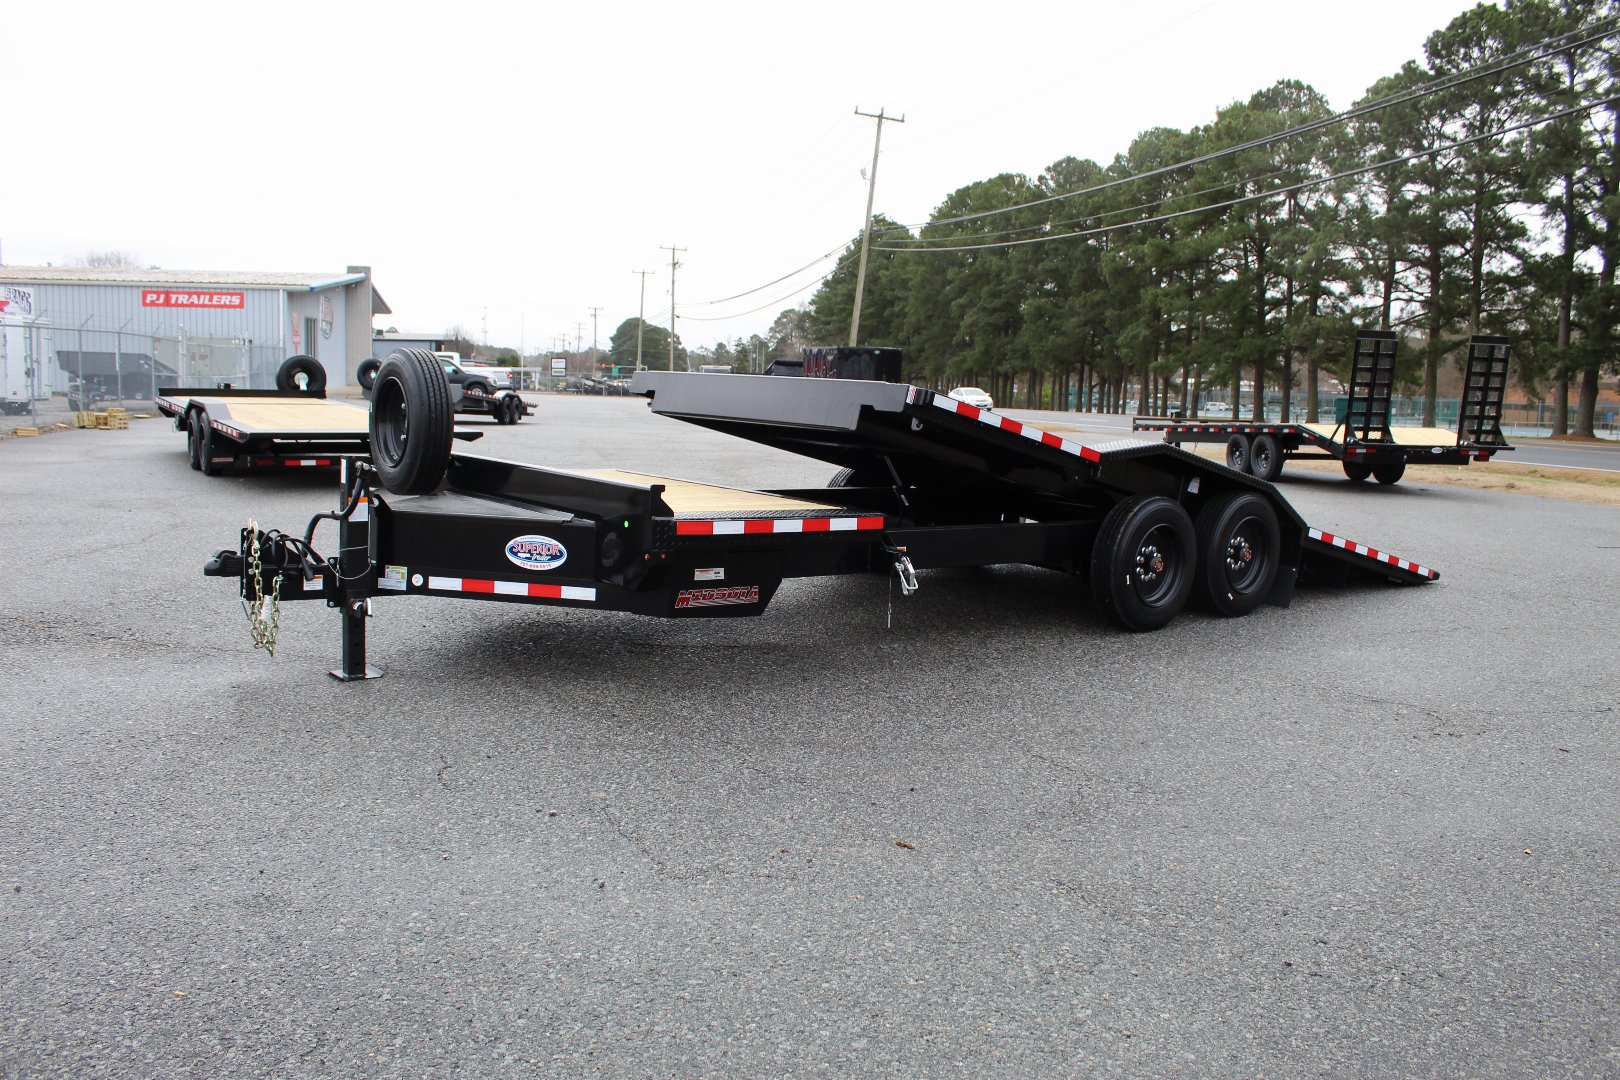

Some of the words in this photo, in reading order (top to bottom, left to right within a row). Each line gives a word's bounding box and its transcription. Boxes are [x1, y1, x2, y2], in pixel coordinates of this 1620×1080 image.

[145, 293, 166, 304] PJ
[169, 294, 241, 306] TRAILERS
[512, 539, 561, 556] SUPERIOR
[674, 585, 759, 609] MIDSOTA
